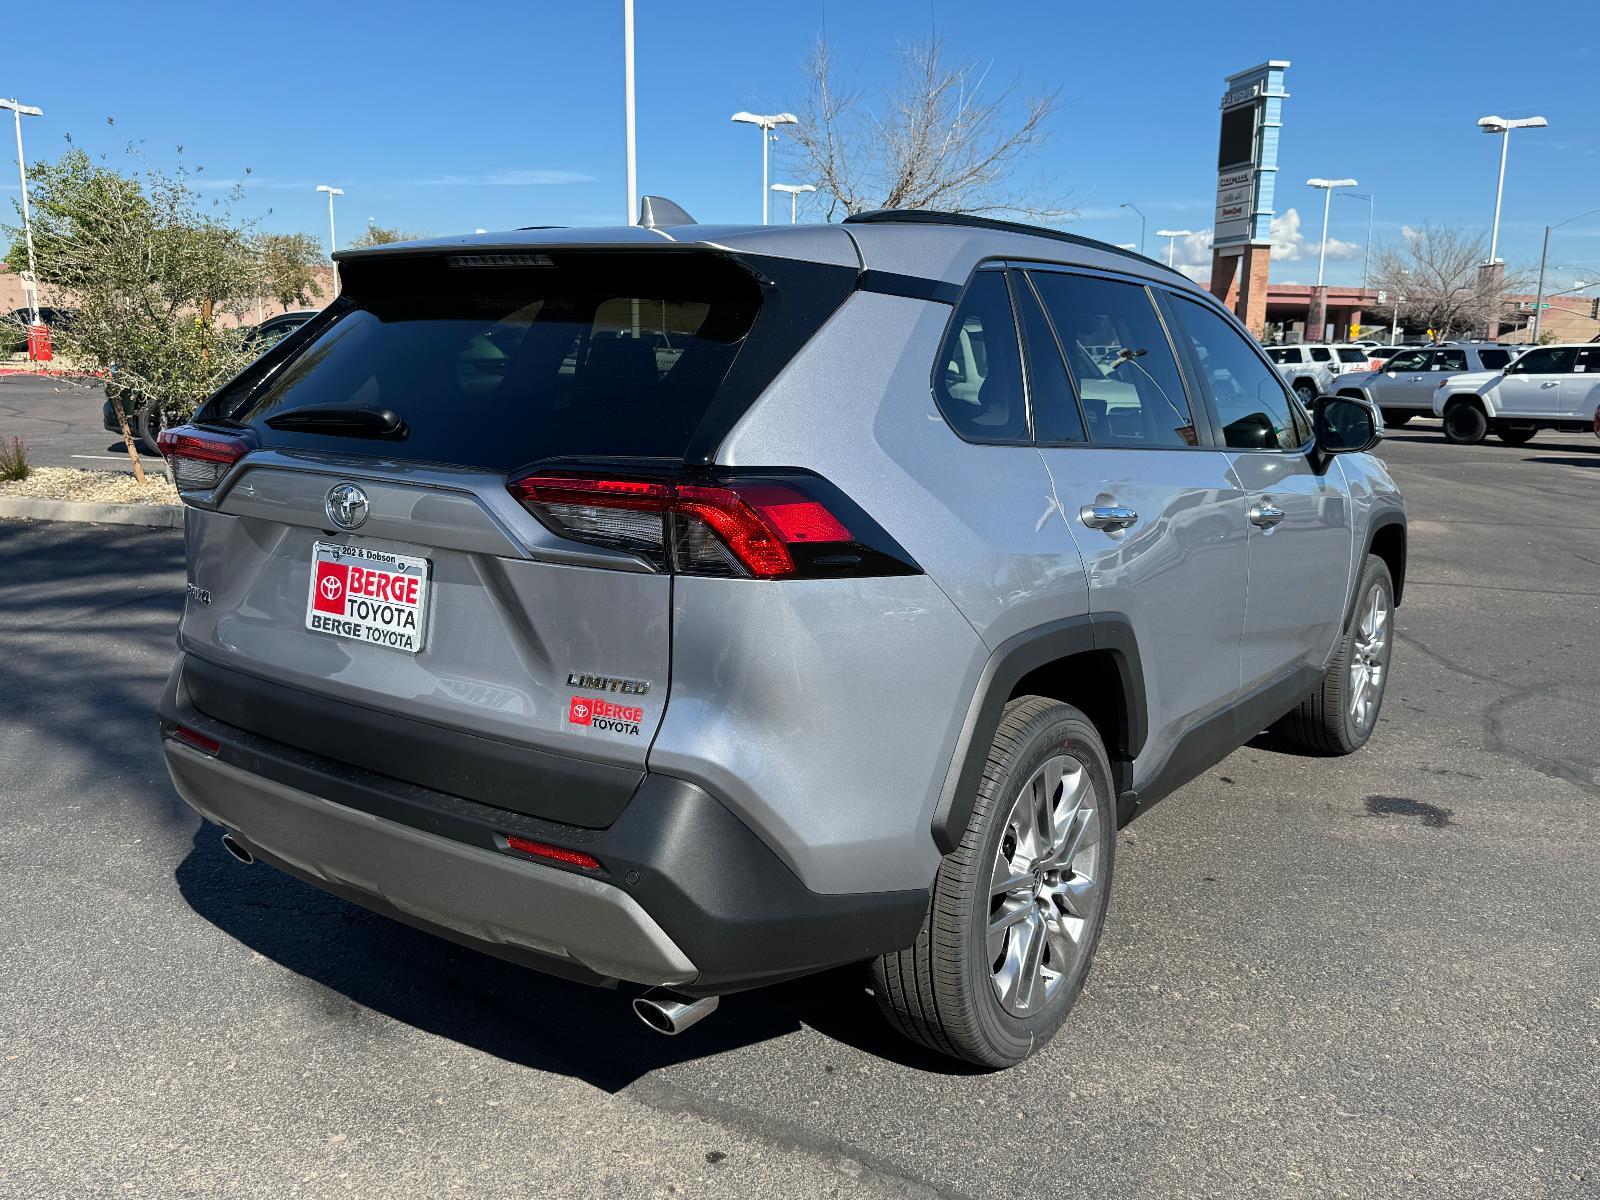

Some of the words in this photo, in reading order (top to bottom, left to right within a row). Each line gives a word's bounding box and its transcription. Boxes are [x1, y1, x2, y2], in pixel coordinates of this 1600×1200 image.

[342, 547, 356, 557] 202
[358, 549, 365, 558] &
[366, 551, 396, 563] Dobson
[349, 567, 418, 604] BERGE
[348, 599, 415, 629] TOYOTA
[312, 615, 361, 637] BERGE
[366, 626, 413, 649] TOYOTA
[566, 673, 650, 695] LIMITED
[594, 699, 643, 722] BERGE
[593, 718, 639, 735] TOYOTA
